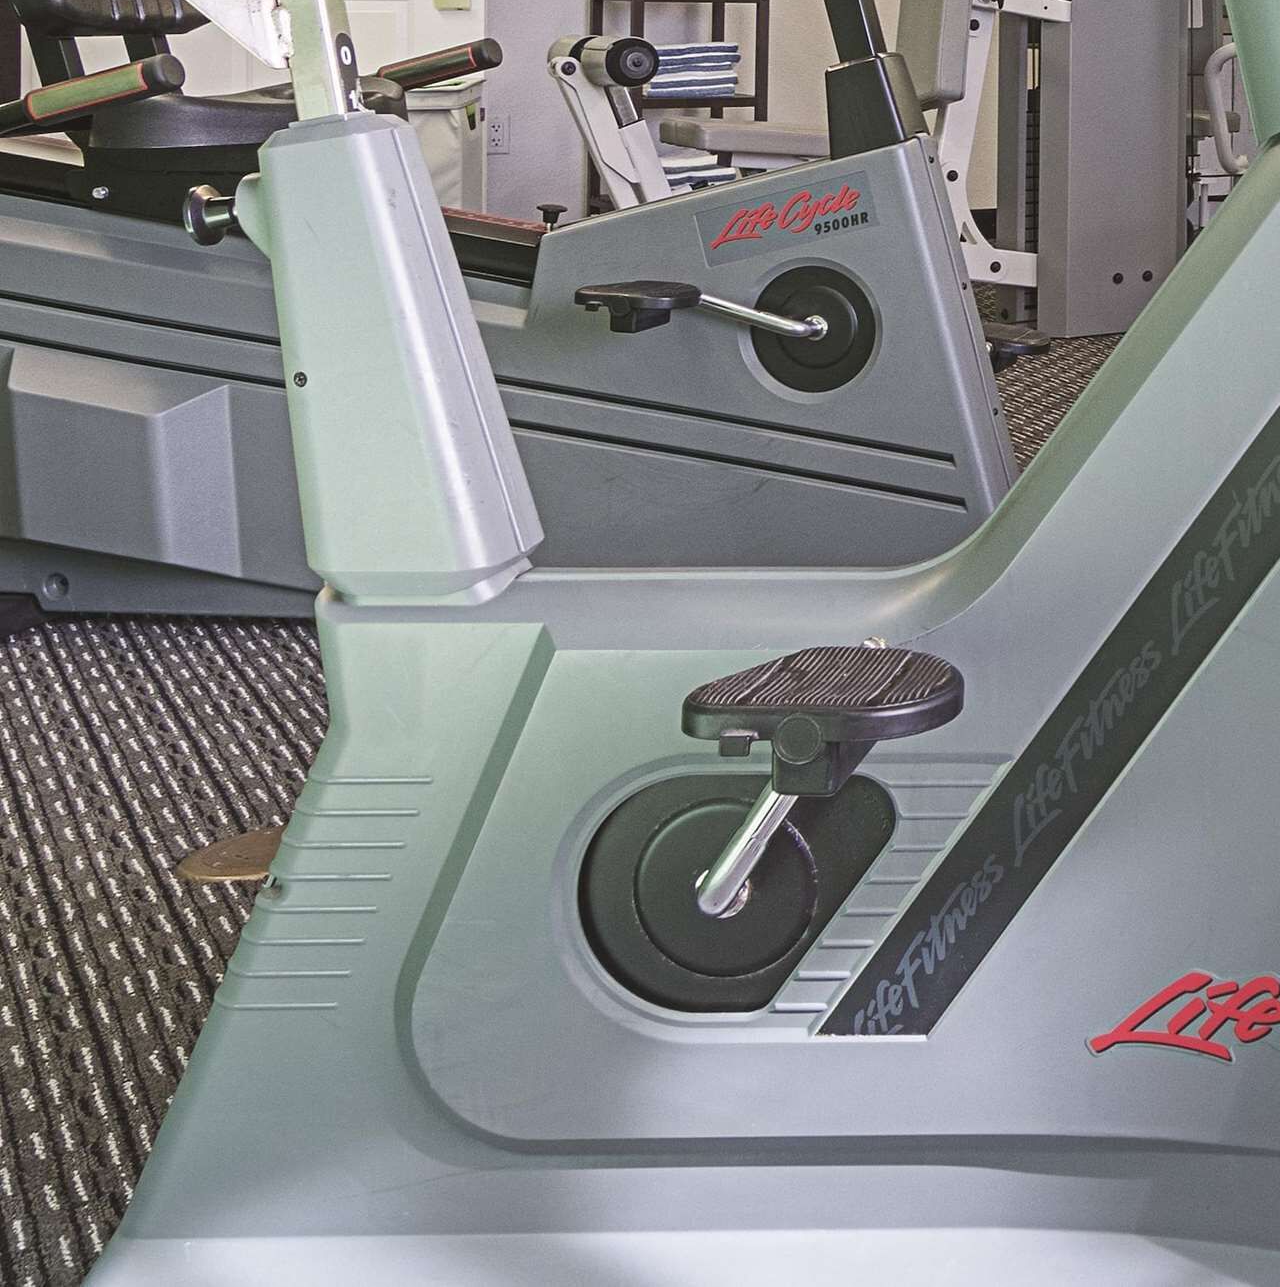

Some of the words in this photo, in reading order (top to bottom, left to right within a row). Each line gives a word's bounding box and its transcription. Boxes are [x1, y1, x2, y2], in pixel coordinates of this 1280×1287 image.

[341, 46, 352, 65] 0
[814, 212, 869, 235] 9500HR
[1012, 640, 1164, 866] LifeFitness
